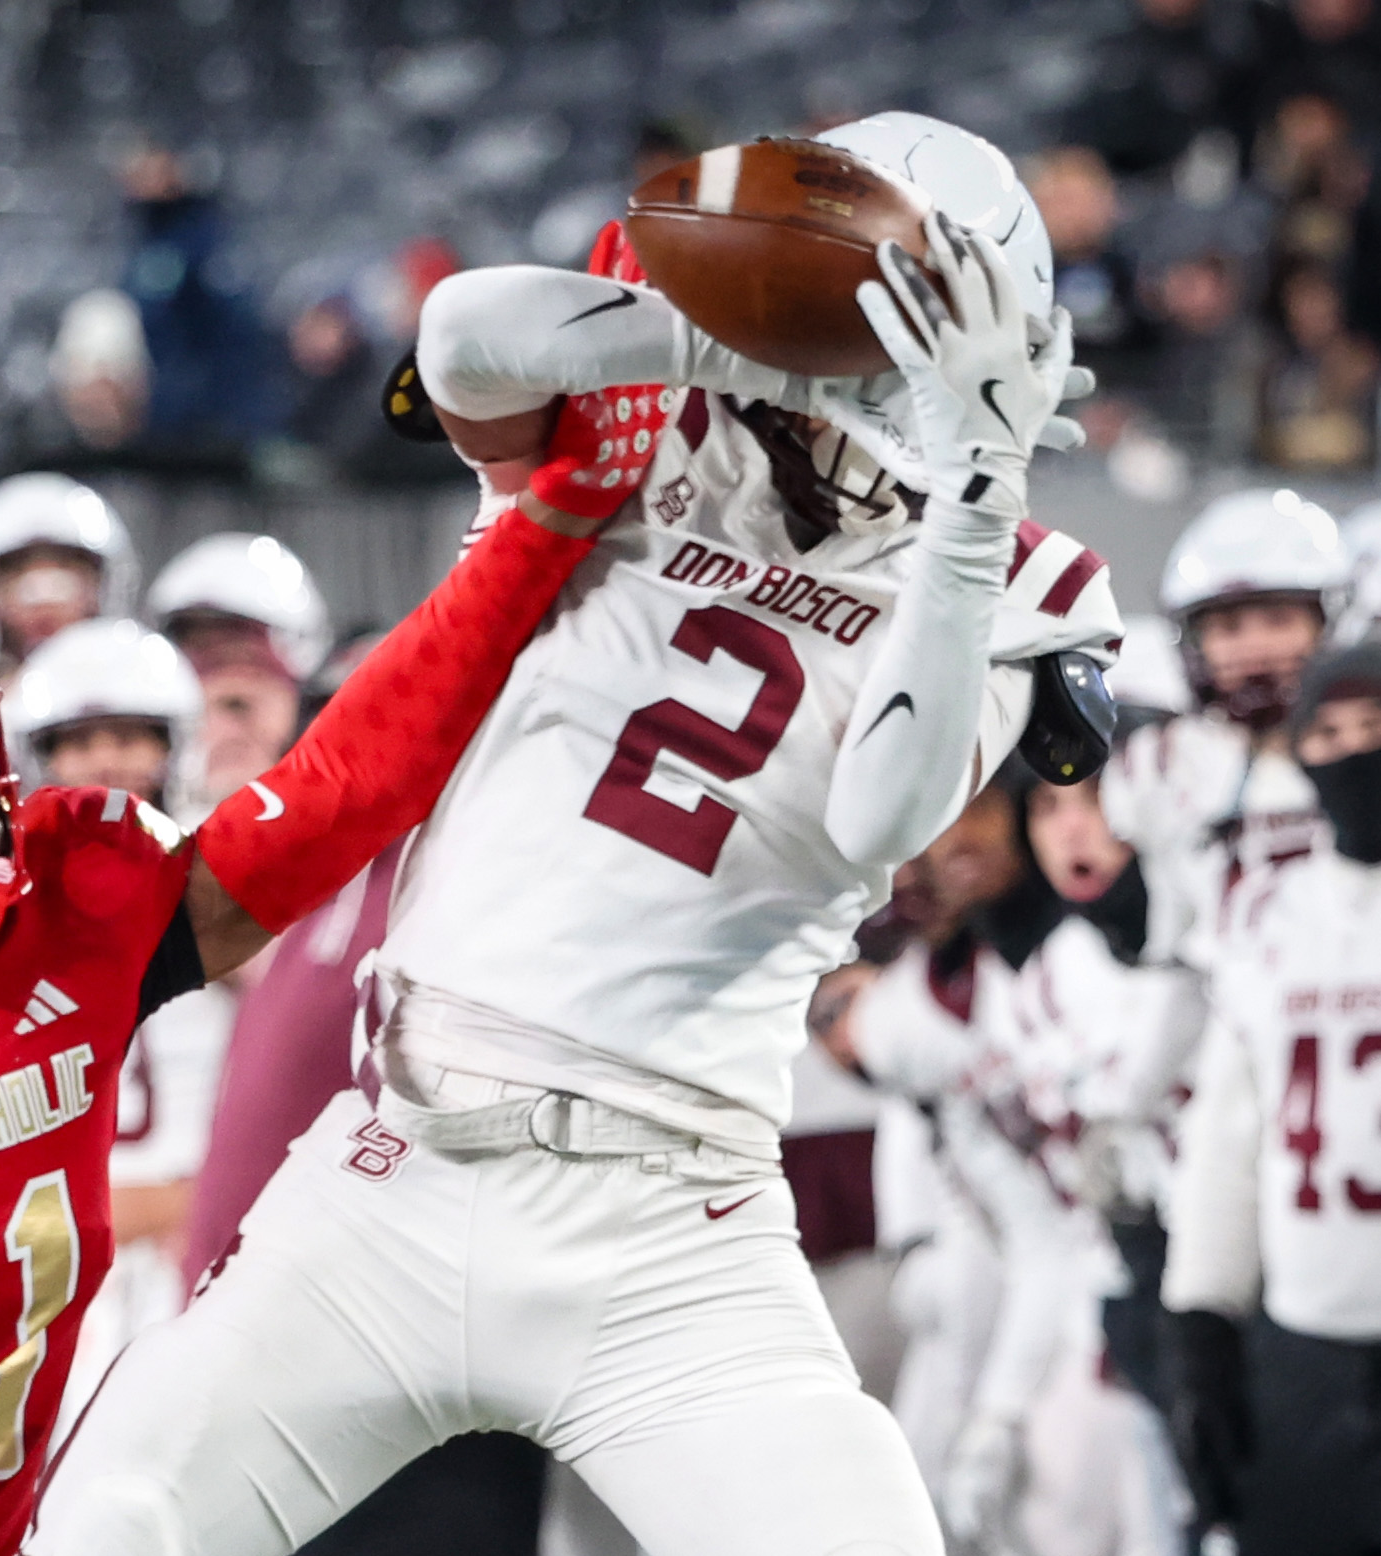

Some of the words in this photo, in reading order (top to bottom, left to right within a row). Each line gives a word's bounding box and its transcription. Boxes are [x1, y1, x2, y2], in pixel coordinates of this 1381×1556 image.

[660, 541, 758, 589] DON
[744, 565, 880, 646] BOSCO
[581, 603, 806, 878] 2
